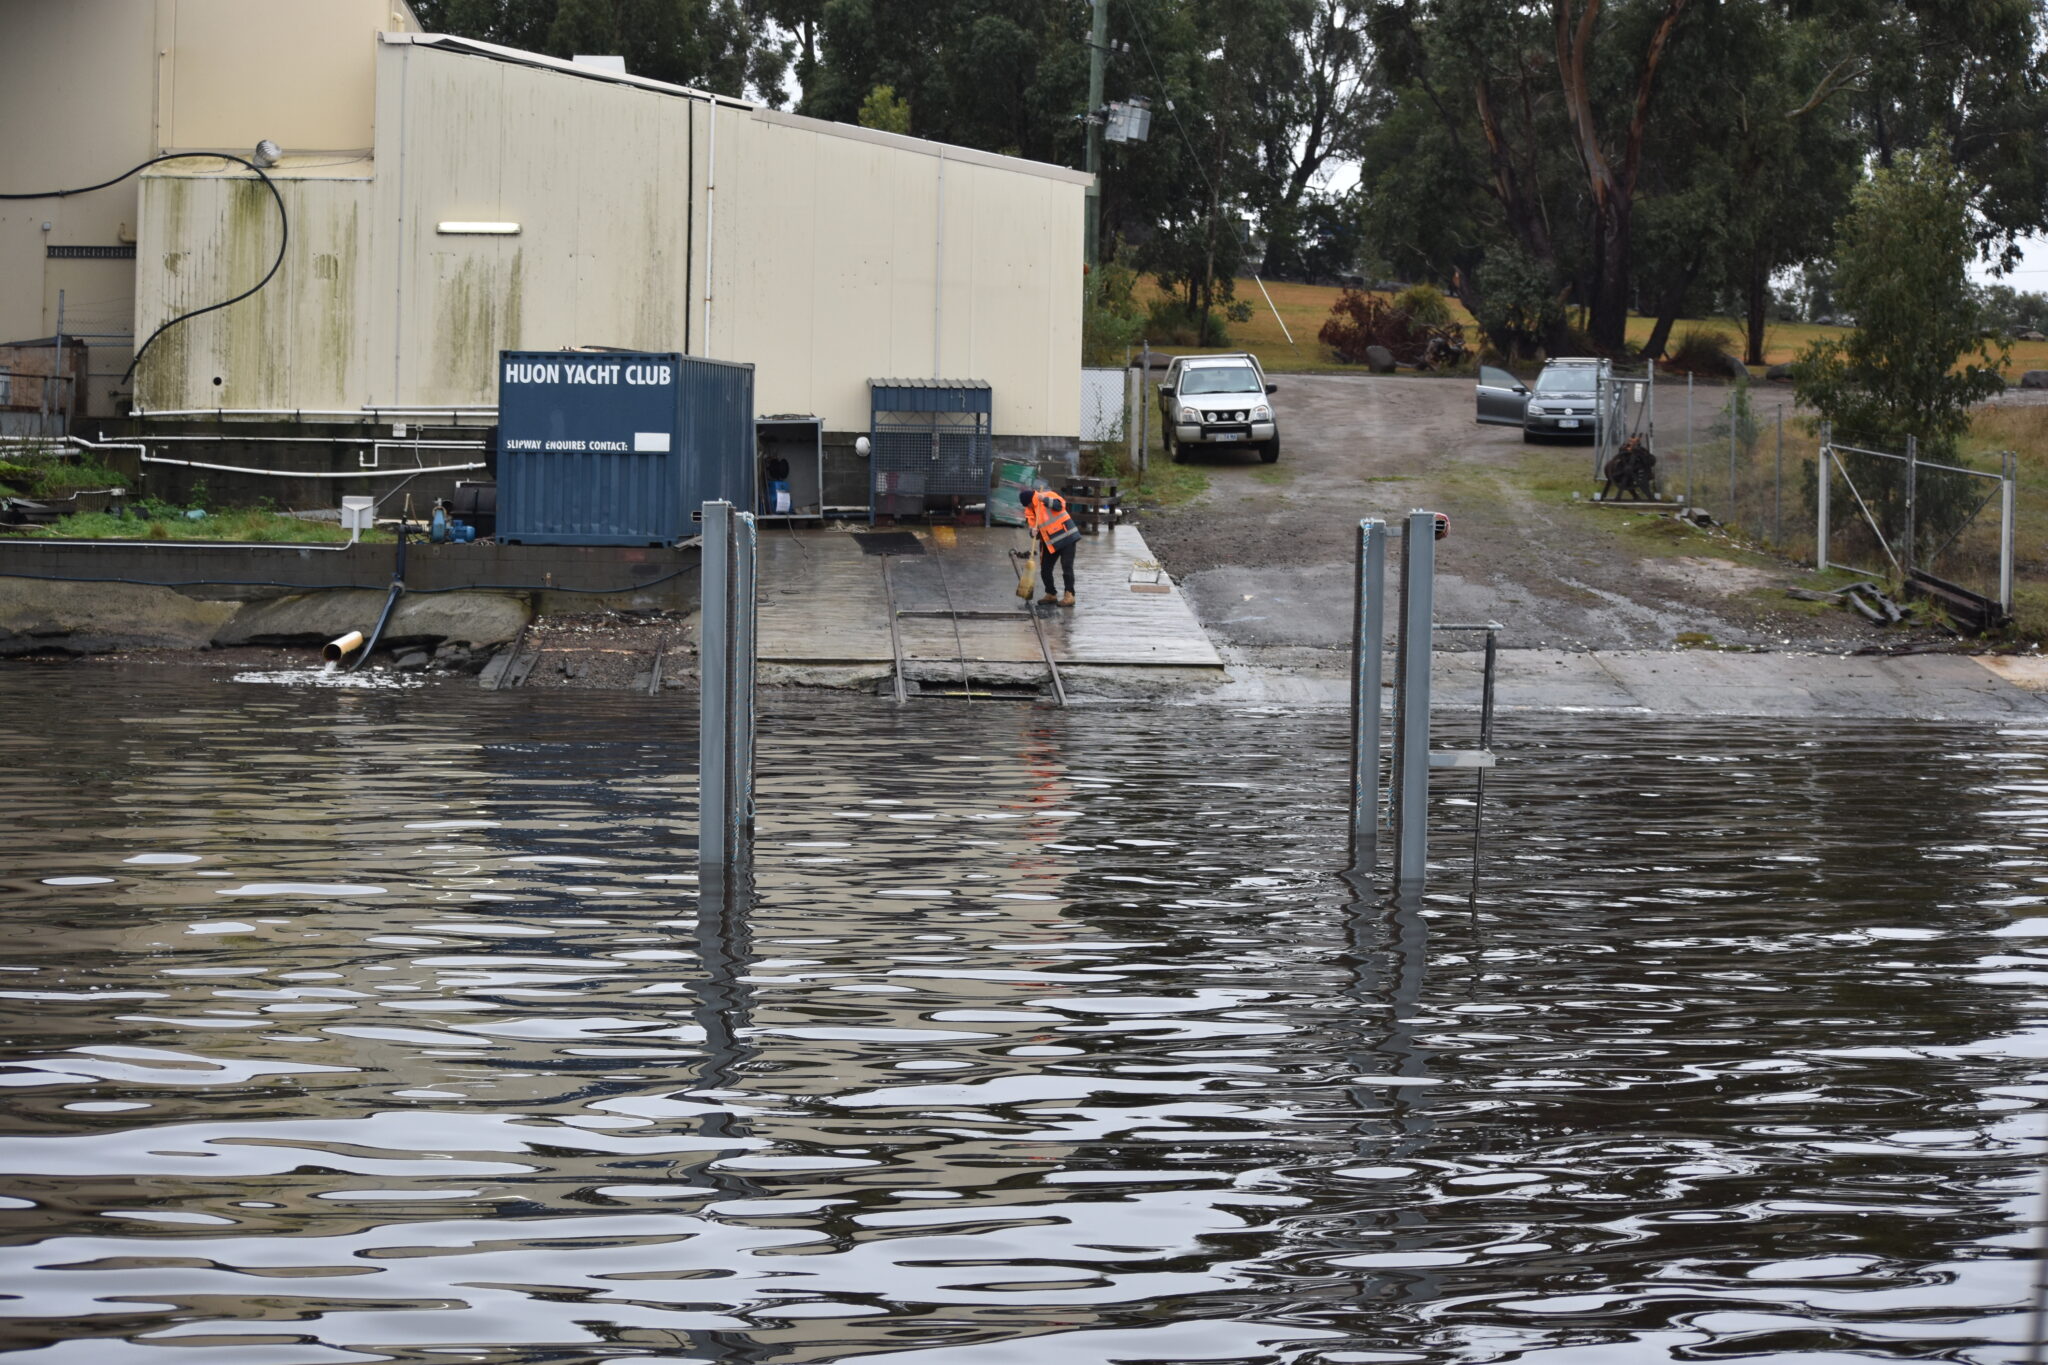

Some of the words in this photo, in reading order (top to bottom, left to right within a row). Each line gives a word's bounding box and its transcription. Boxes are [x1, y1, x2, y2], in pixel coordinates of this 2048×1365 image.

[505, 363, 560, 384] HUON
[563, 364, 621, 385] YACHT
[625, 365, 671, 385] CLUB
[506, 439, 542, 450] SLIPWAY
[545, 440, 586, 450] ENQUIRES
[588, 440, 628, 451] CONTACT:
